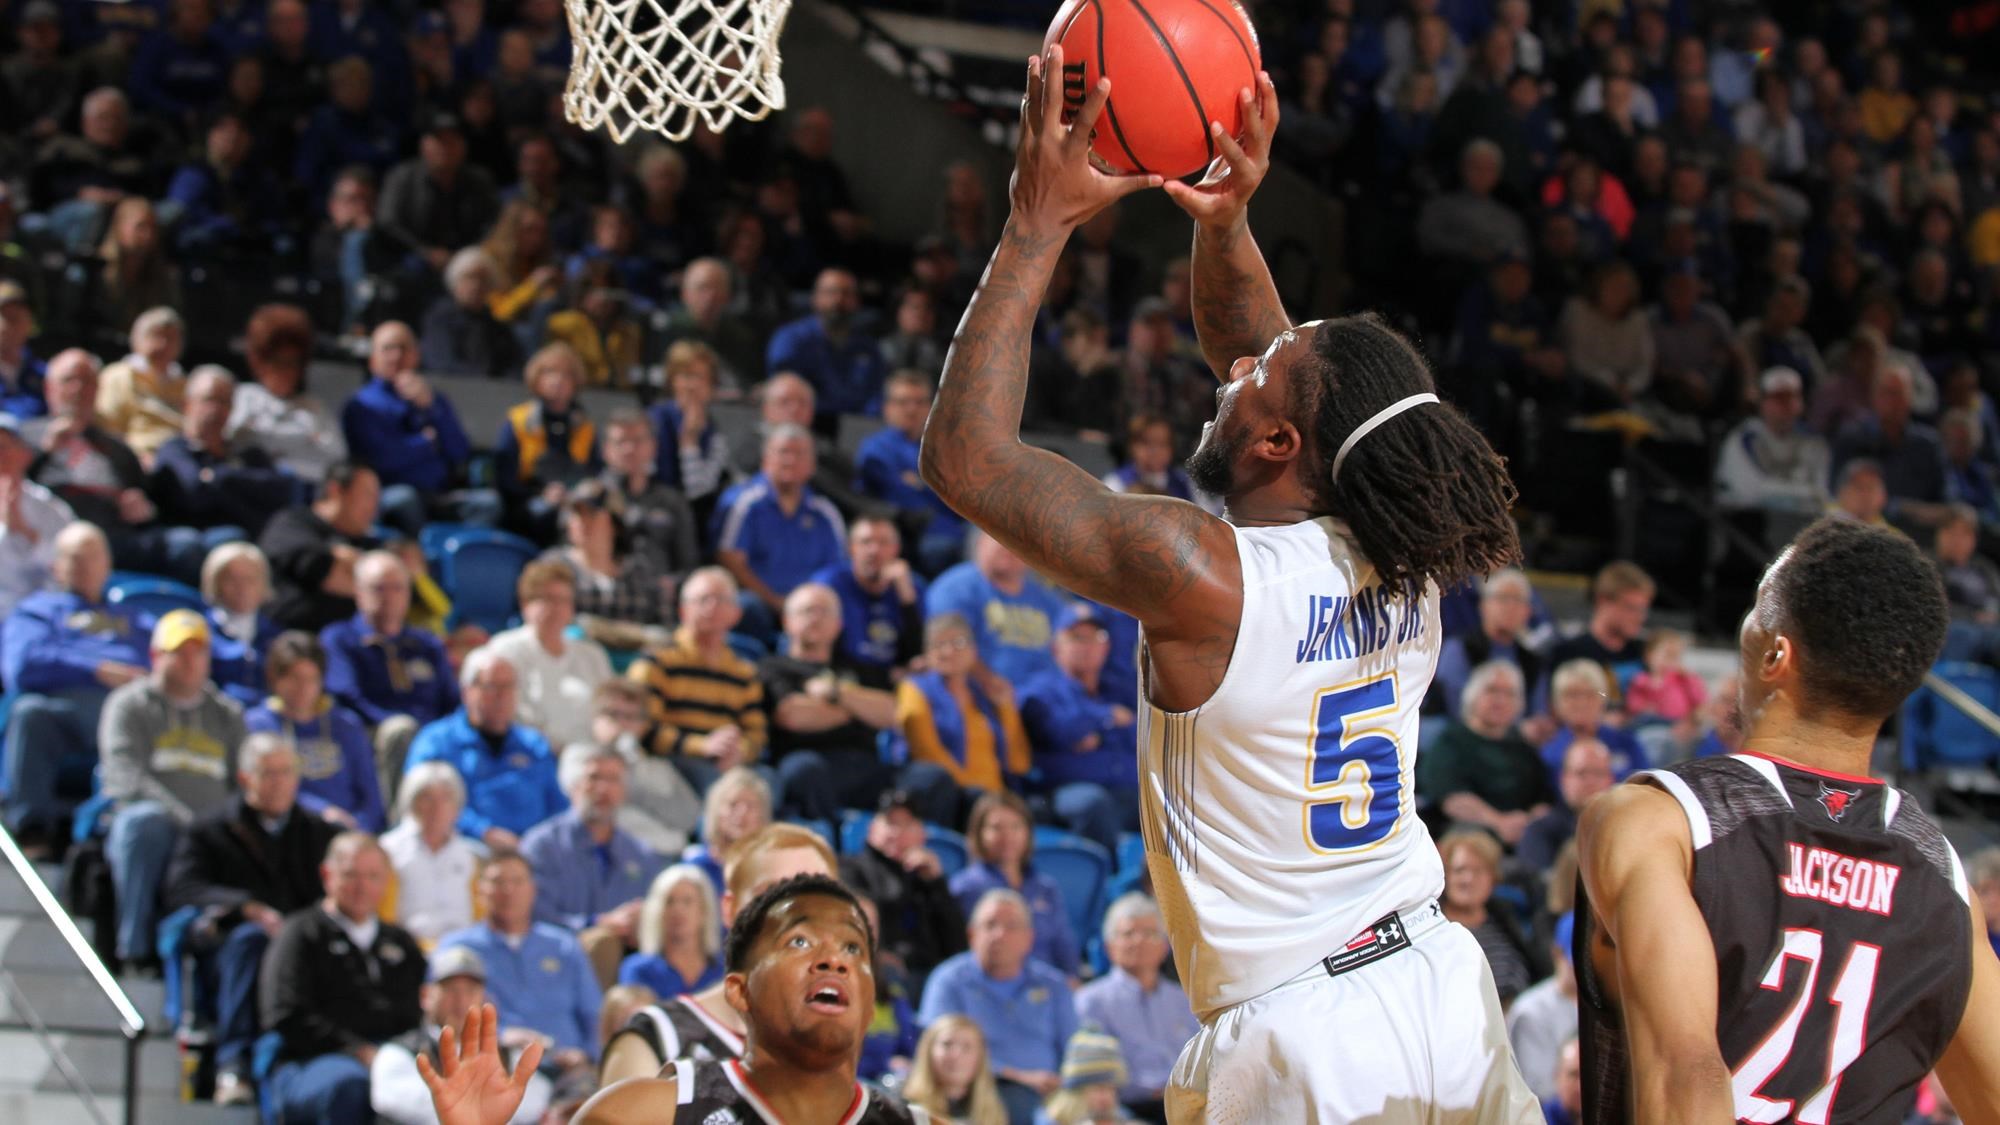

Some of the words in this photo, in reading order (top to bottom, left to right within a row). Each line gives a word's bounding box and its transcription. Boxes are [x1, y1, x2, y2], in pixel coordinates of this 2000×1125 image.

[1296, 583, 1390, 663] JENKINS
[1302, 671, 1406, 856] 5
[1731, 927, 1882, 1125] 21
